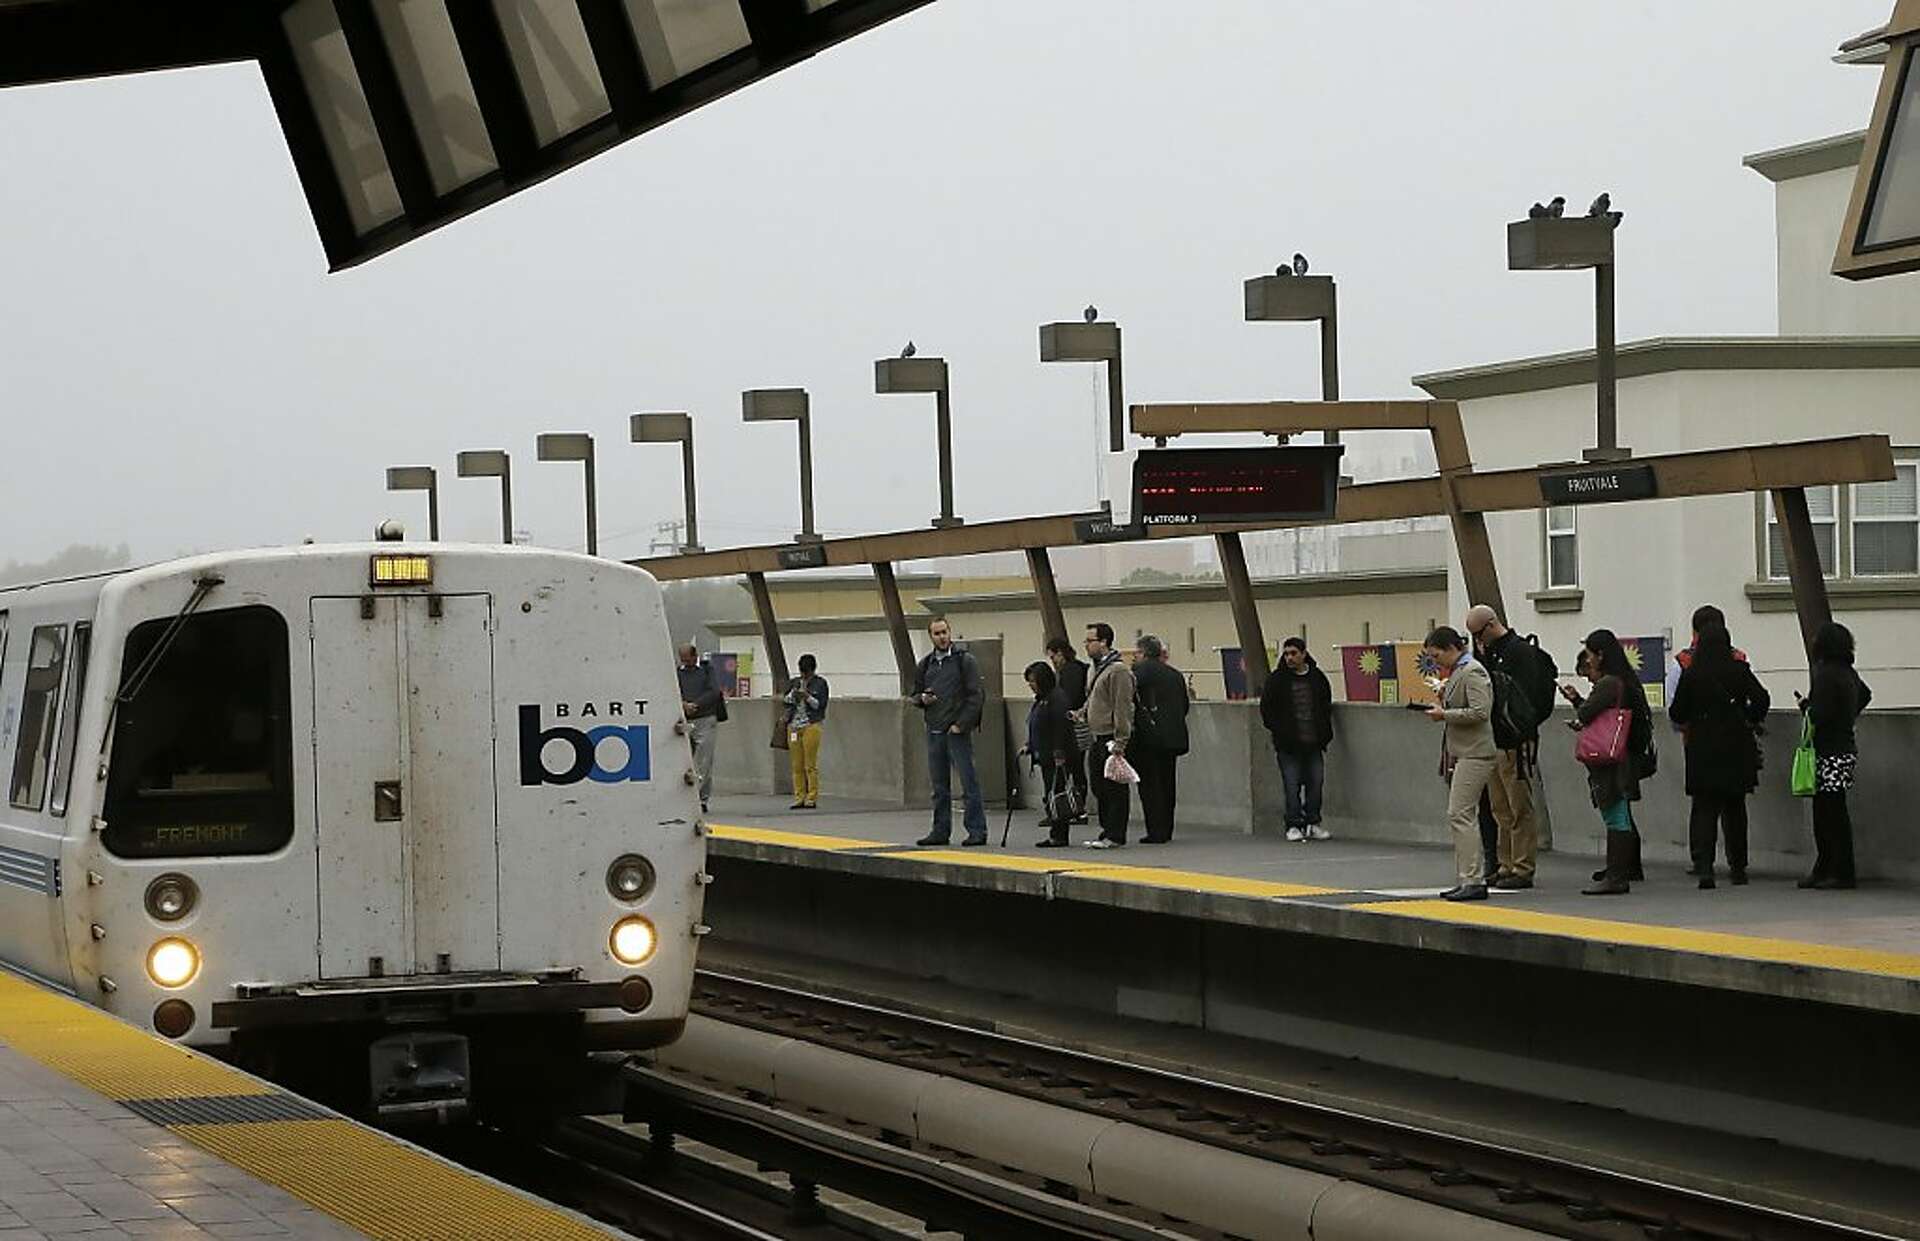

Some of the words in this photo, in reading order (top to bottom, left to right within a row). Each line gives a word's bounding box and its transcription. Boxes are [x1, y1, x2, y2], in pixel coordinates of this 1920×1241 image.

[1143, 514, 1188, 524] PLATFORM
[1190, 514, 1197, 523] 2
[556, 700, 648, 717] BART
[156, 824, 248, 841] FREMONT
